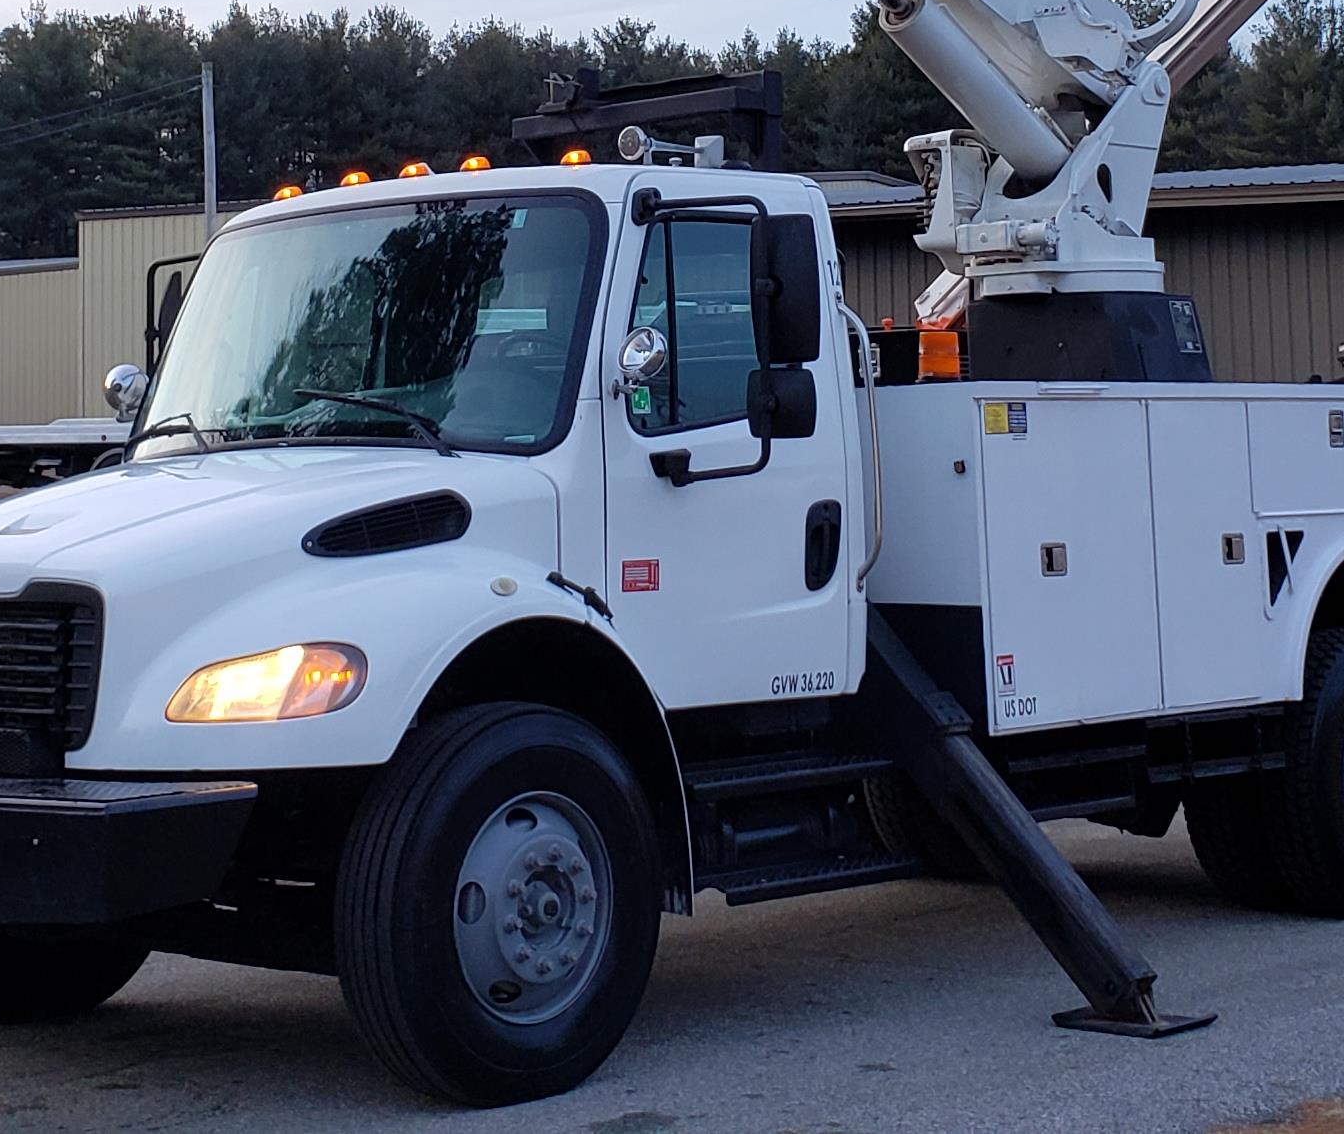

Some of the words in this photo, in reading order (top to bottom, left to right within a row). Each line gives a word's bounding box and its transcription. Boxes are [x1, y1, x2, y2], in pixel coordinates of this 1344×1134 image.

[771, 674, 799, 695] GVW
[801, 671, 835, 693] 36,220
[1004, 699, 1016, 718] US
[1018, 697, 1037, 716] DOT
